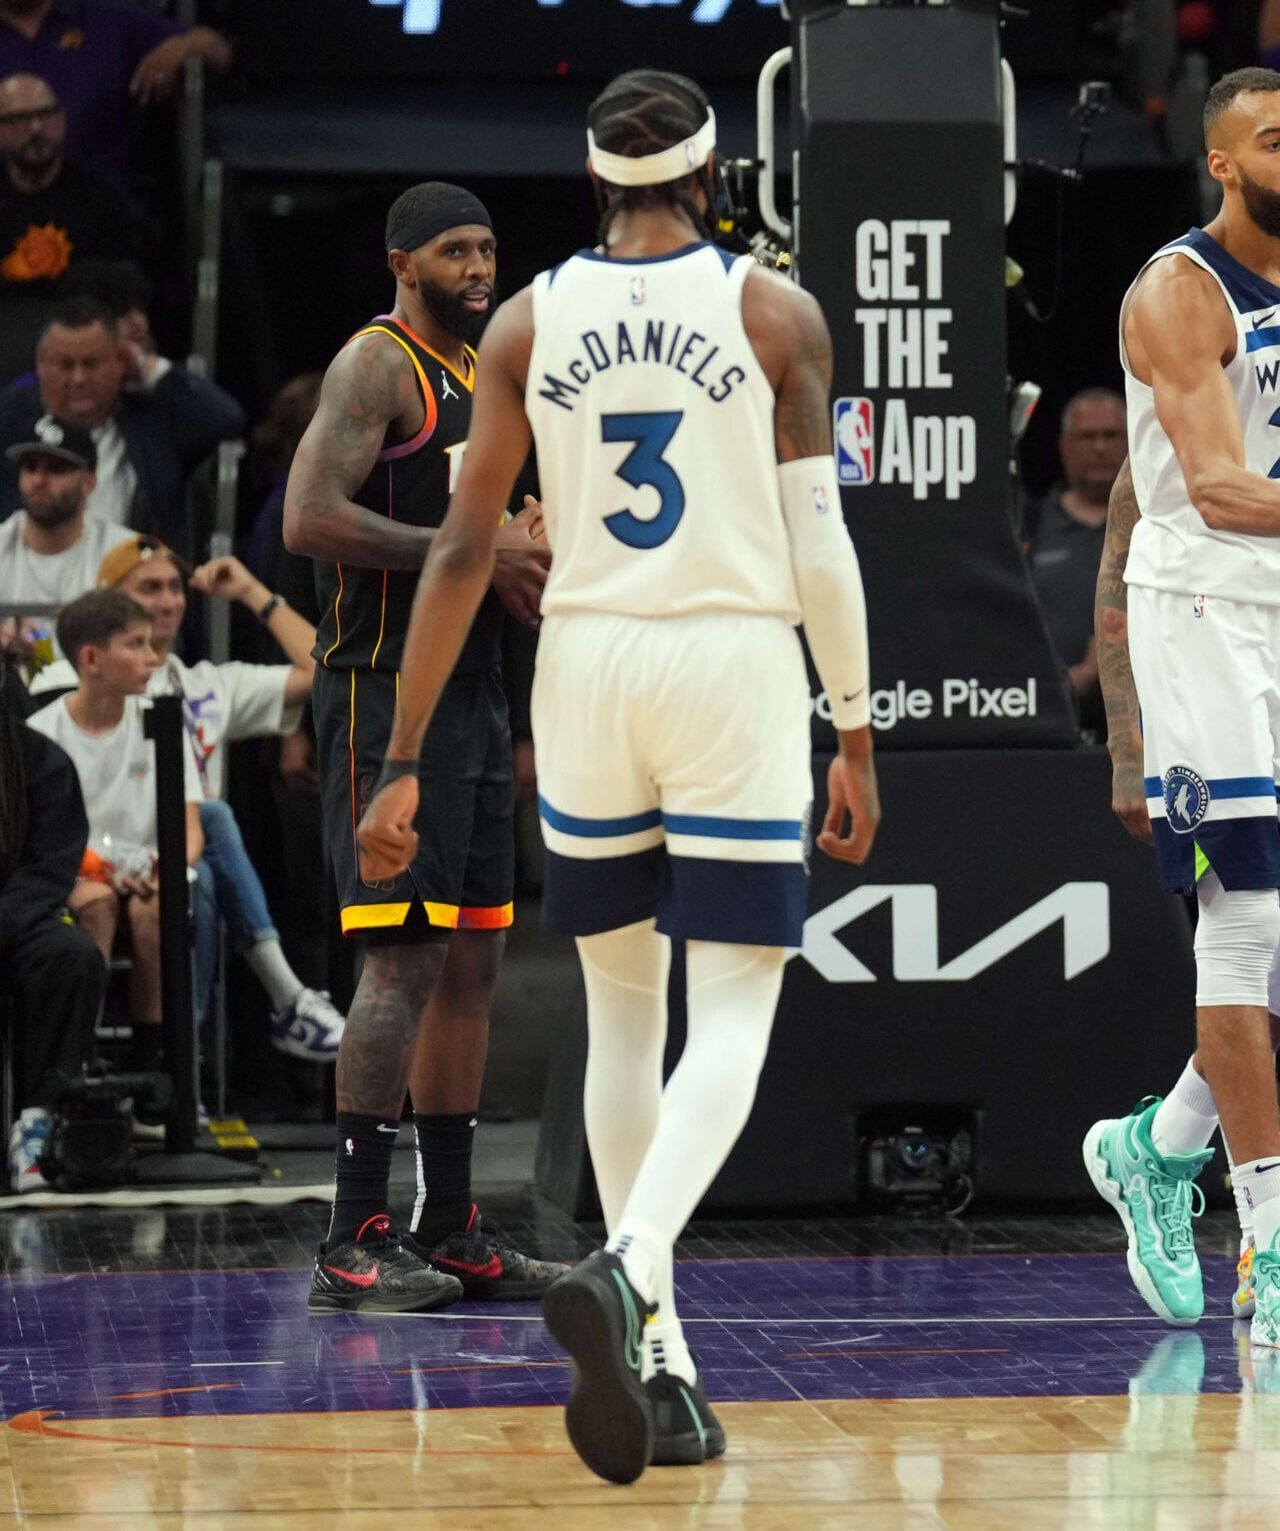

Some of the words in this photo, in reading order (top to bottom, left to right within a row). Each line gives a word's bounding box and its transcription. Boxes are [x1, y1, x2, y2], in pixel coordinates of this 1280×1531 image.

[855, 219, 951, 301] GET
[538, 320, 746, 412] McDANIELS
[854, 308, 953, 389] THE
[600, 410, 686, 551] 3
[879, 398, 977, 501] App
[943, 677, 1037, 718] Pixel
